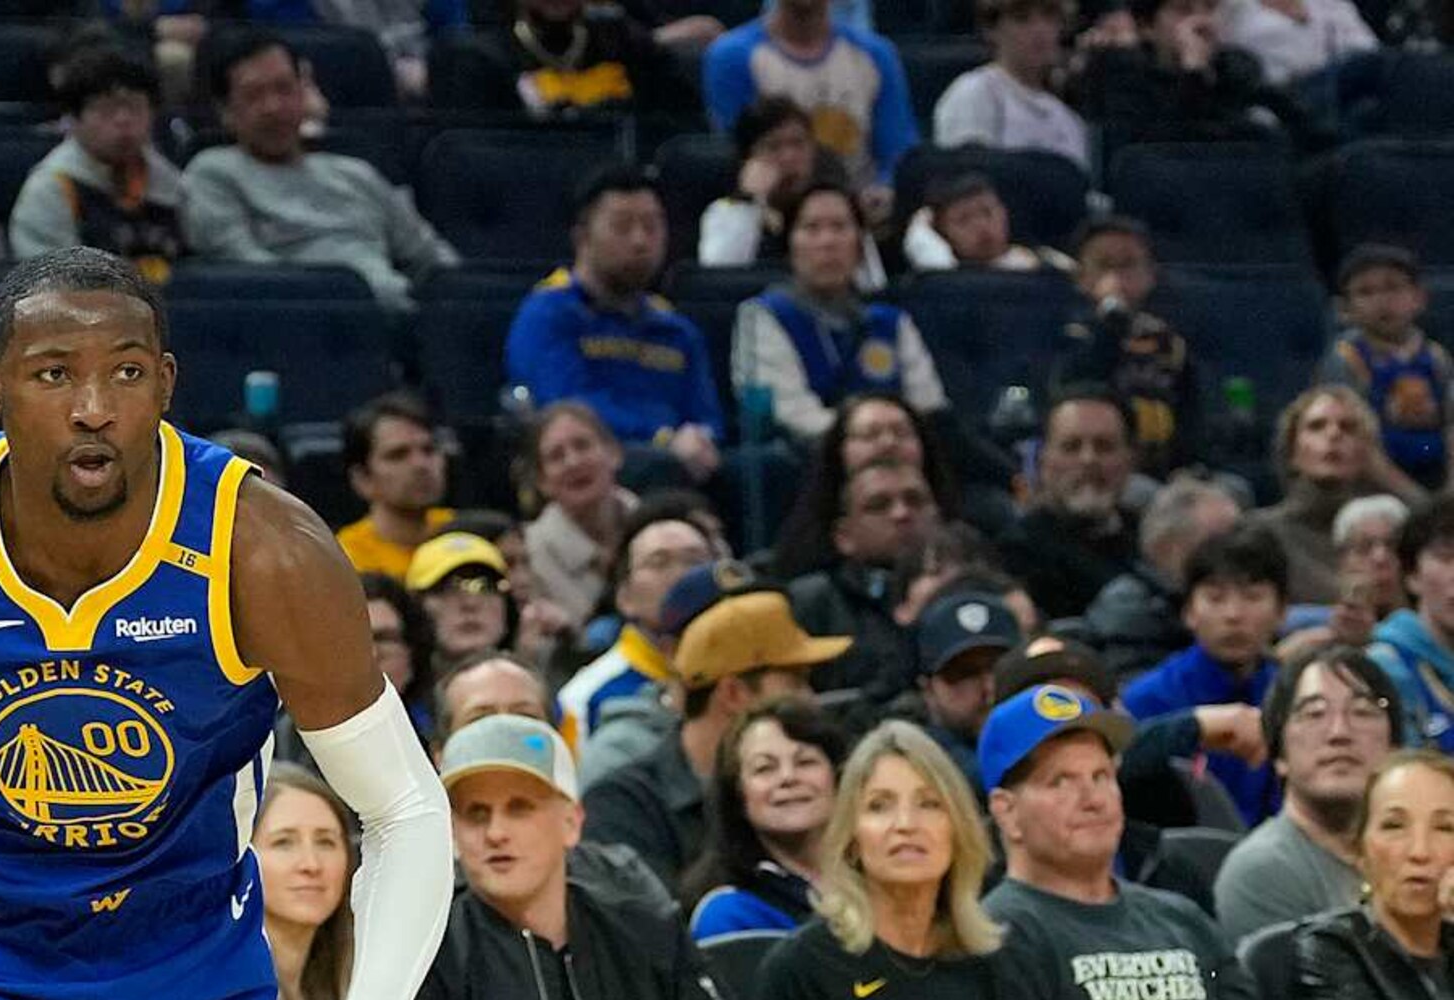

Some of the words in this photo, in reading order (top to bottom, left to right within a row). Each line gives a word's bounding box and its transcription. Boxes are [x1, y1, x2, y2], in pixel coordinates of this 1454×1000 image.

[178, 550, 197, 568] 16
[115, 616, 198, 638] Rakuten
[93, 663, 176, 715] STATE
[80, 719, 151, 758] 00
